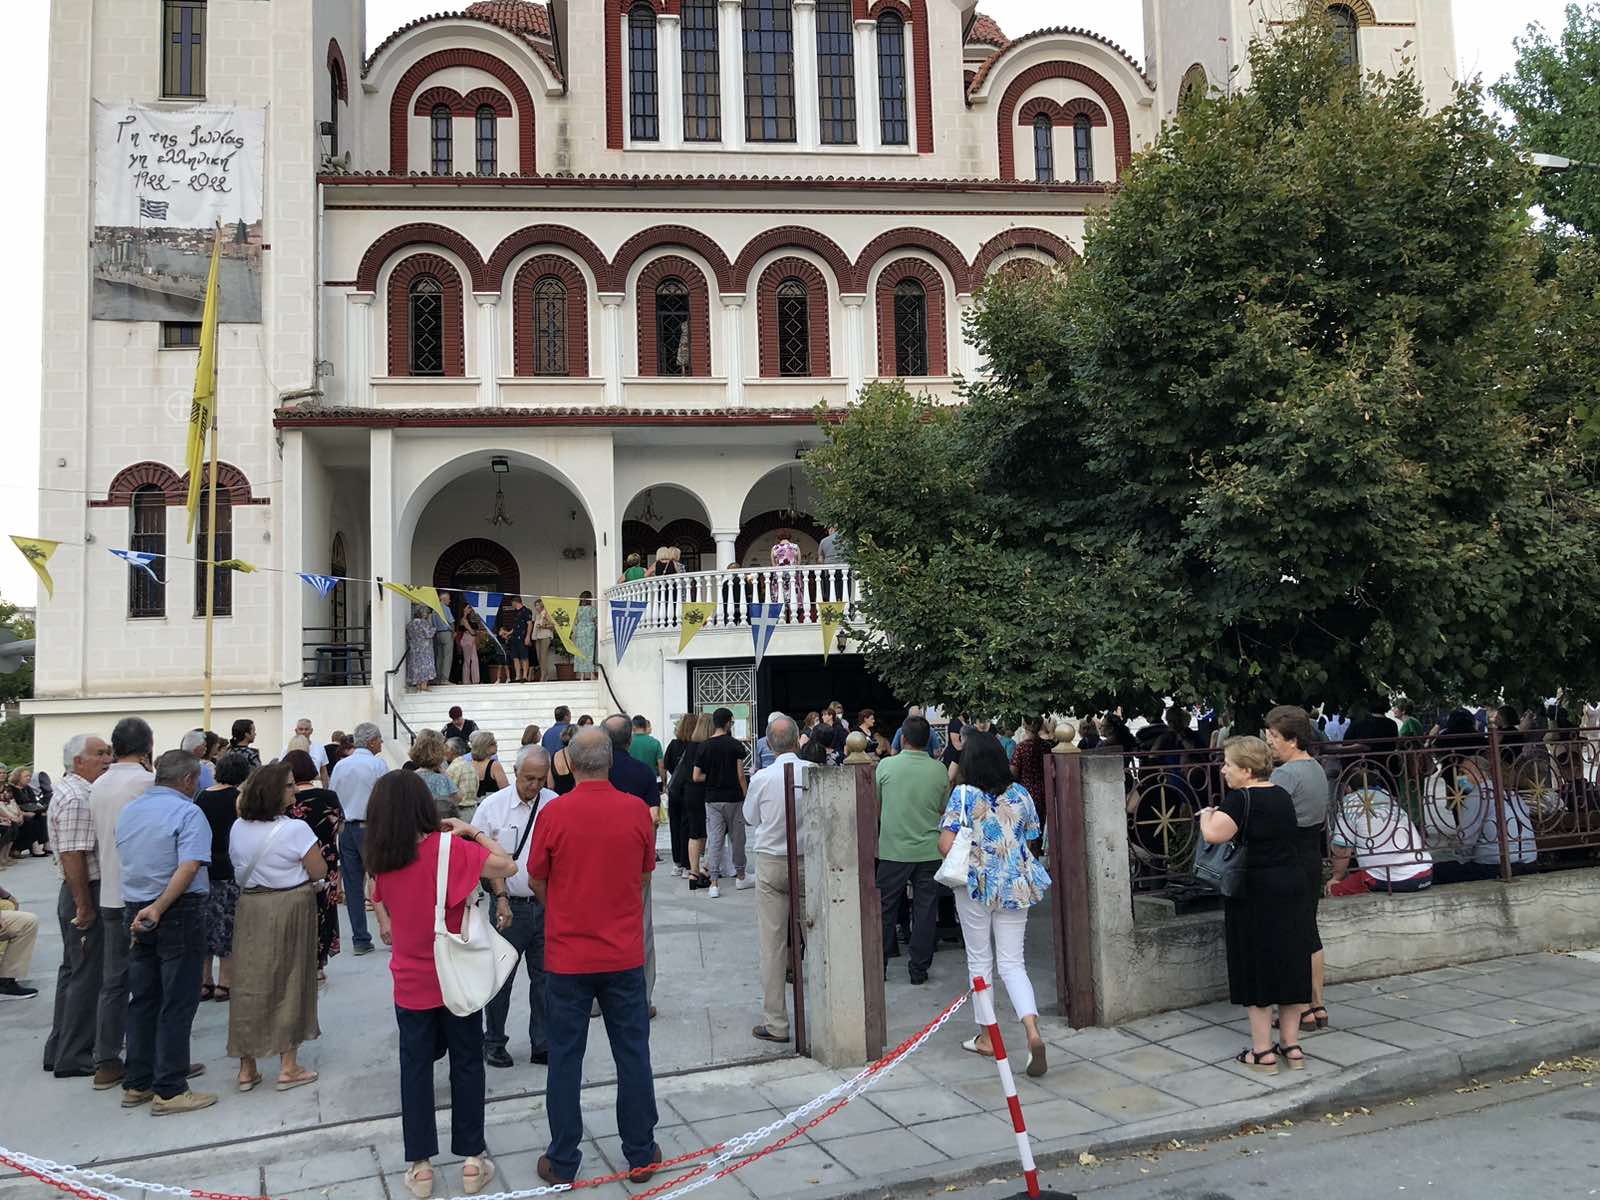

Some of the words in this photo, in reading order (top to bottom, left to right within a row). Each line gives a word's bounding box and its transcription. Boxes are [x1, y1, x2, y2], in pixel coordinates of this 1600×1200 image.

[117, 116, 140, 147] Γη
[149, 133, 178, 149] της
[189, 125, 246, 149] Ιωνίας
[128, 153, 148, 169] γη
[157, 149, 238, 172] ελληνική
[133, 171, 171, 191] 1922
[188, 172, 233, 193] 2022
